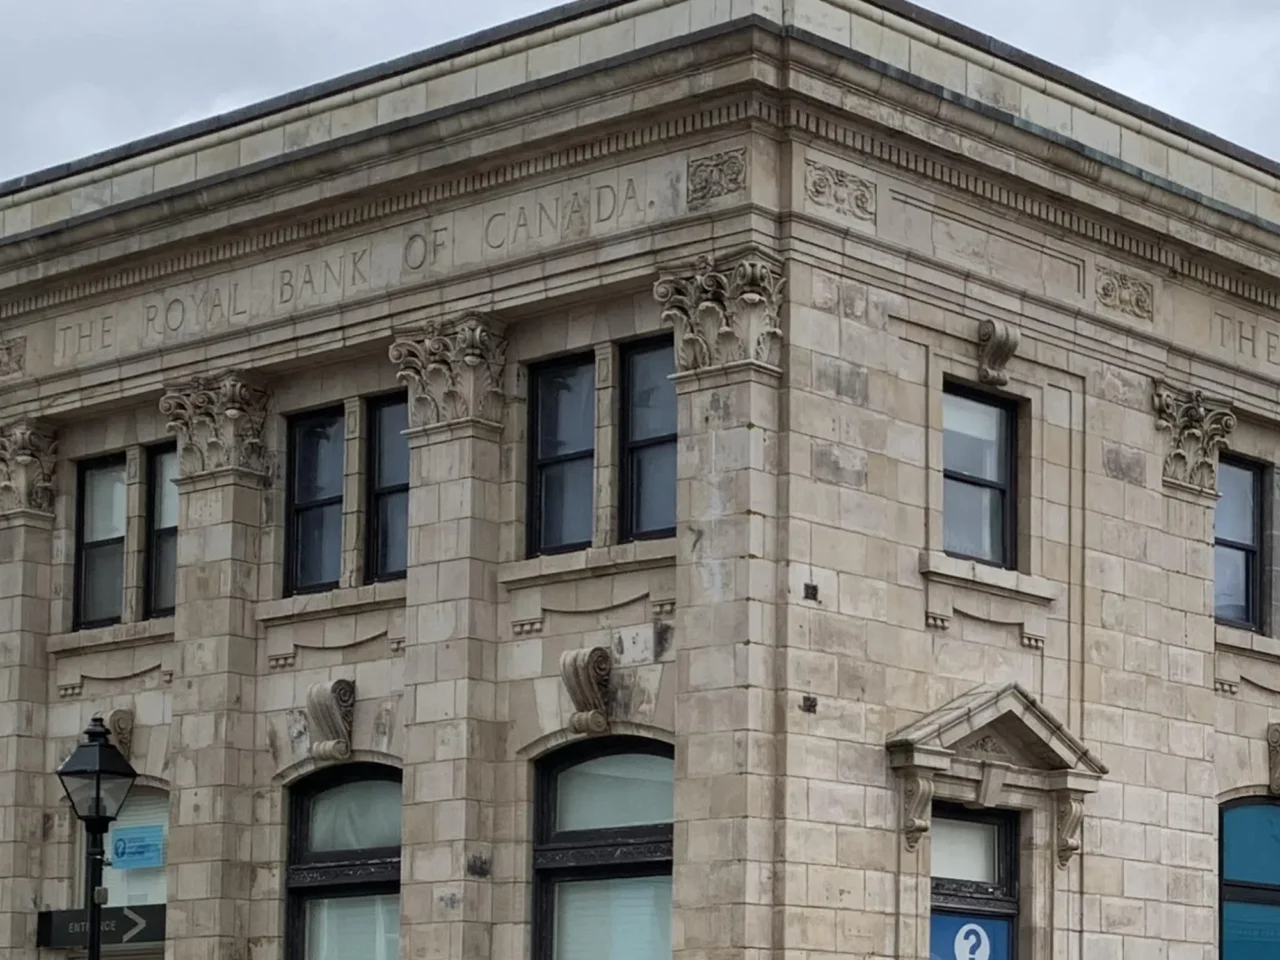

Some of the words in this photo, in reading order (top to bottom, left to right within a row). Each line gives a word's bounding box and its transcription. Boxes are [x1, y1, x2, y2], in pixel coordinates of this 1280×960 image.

[58, 315, 113, 360] THE
[145, 282, 247, 336] ROYAL
[278, 248, 369, 305] BANK
[404, 227, 448, 271] OF
[1214, 311, 1280, 366] THE
[68, 921, 116, 933] ENTNCE
